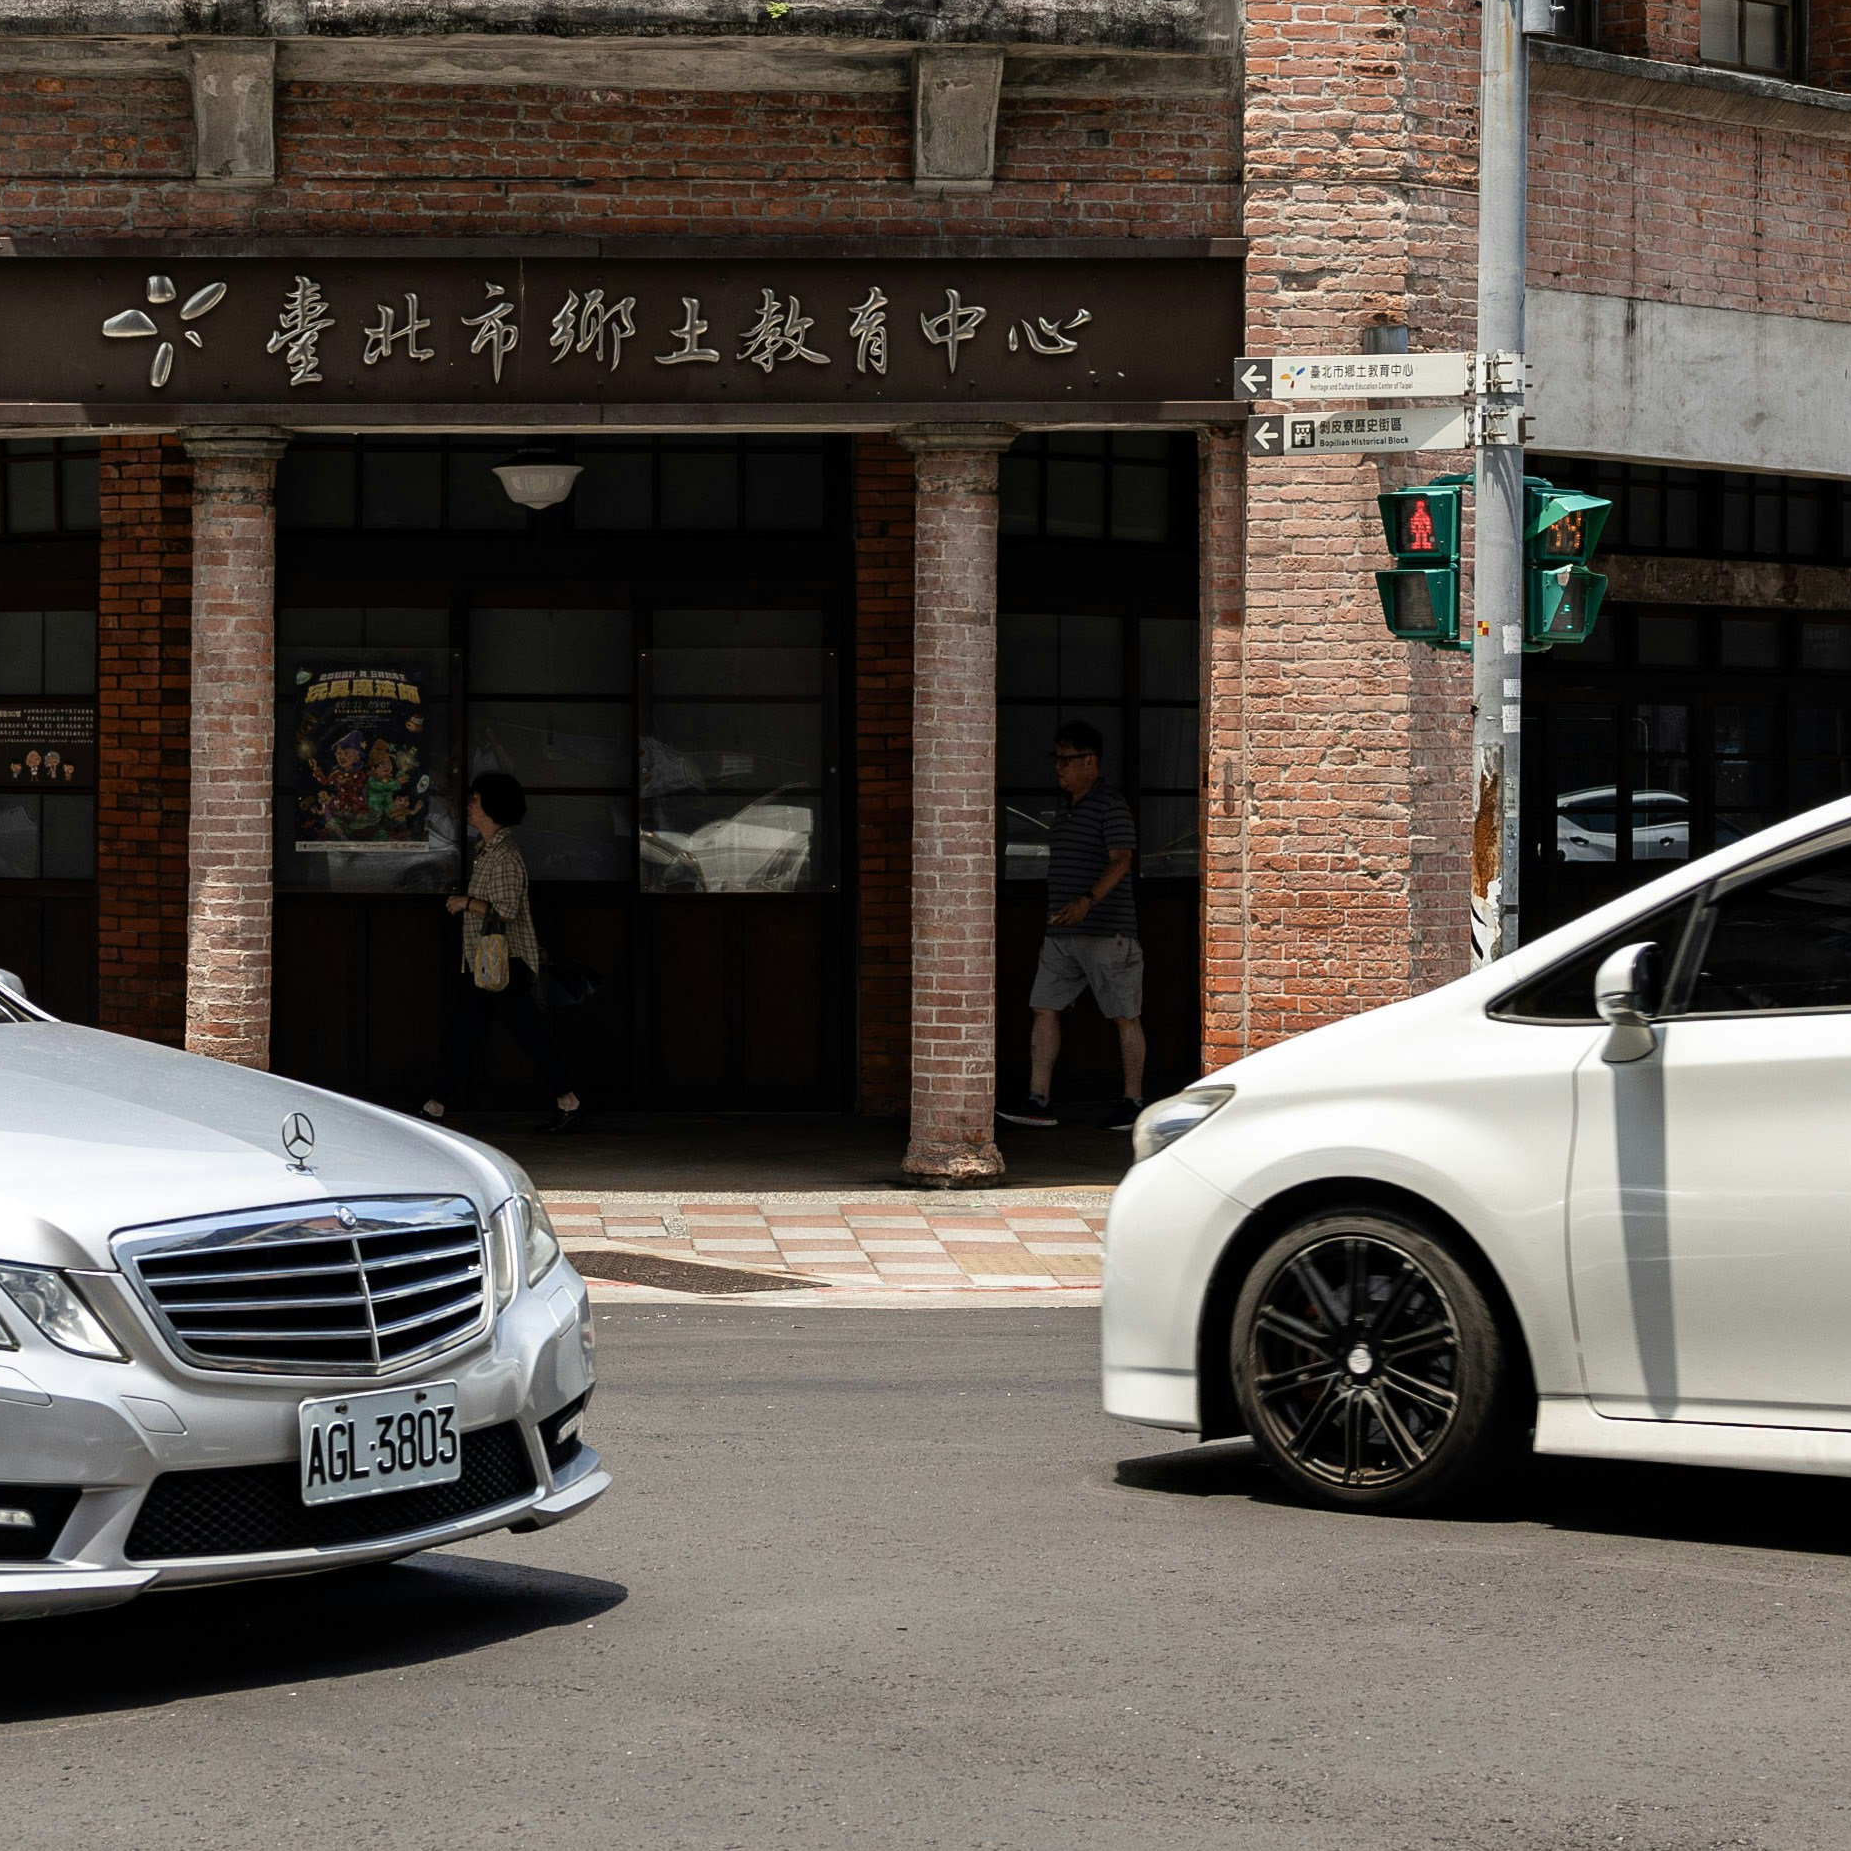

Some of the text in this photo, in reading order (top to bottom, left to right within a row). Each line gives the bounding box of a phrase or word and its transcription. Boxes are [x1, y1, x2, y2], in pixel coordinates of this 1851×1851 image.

[265, 274, 1093, 386] 臺北市鄉土教育中心
[1310, 363, 1414, 379] 臺北市鄉土教育中心
[1319, 436, 1409, 448] Bopiliao Historical Block
